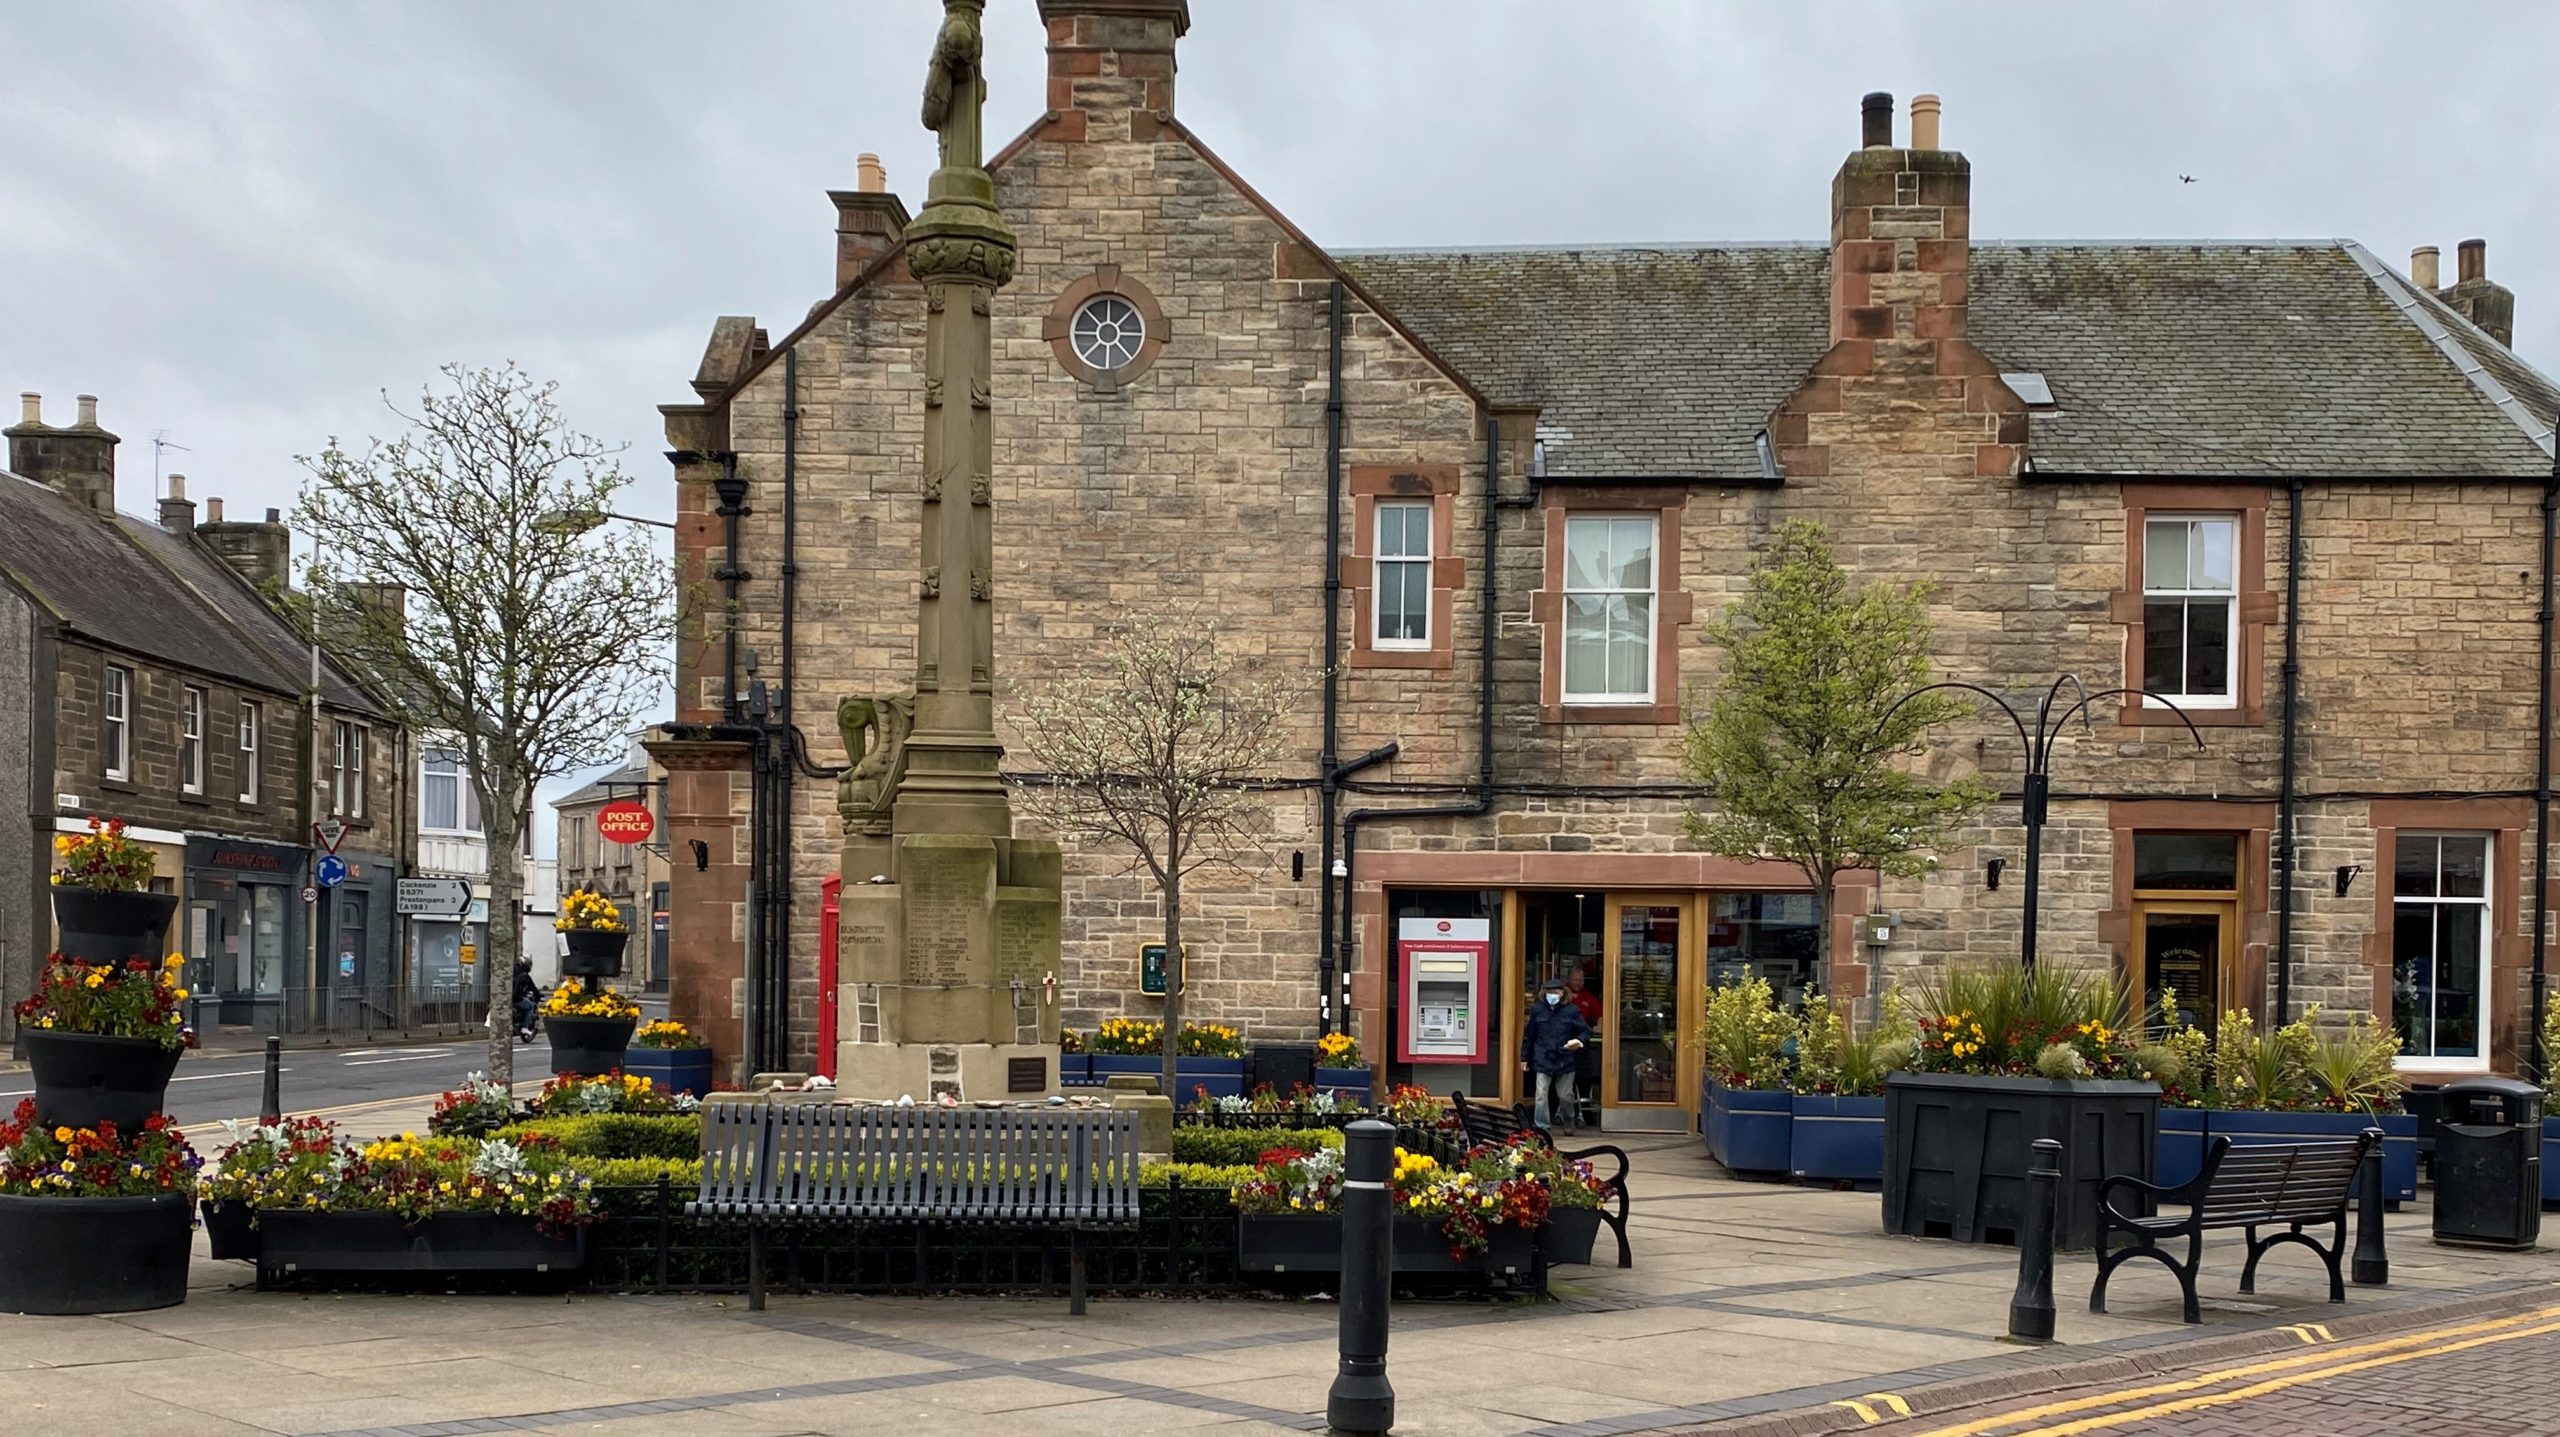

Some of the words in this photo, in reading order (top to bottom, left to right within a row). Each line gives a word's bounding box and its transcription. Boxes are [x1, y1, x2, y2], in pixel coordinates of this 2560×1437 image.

[607, 812, 644, 821] POST
[601, 822, 649, 831] OFFICE
[2161, 948, 2201, 959] Welcome
